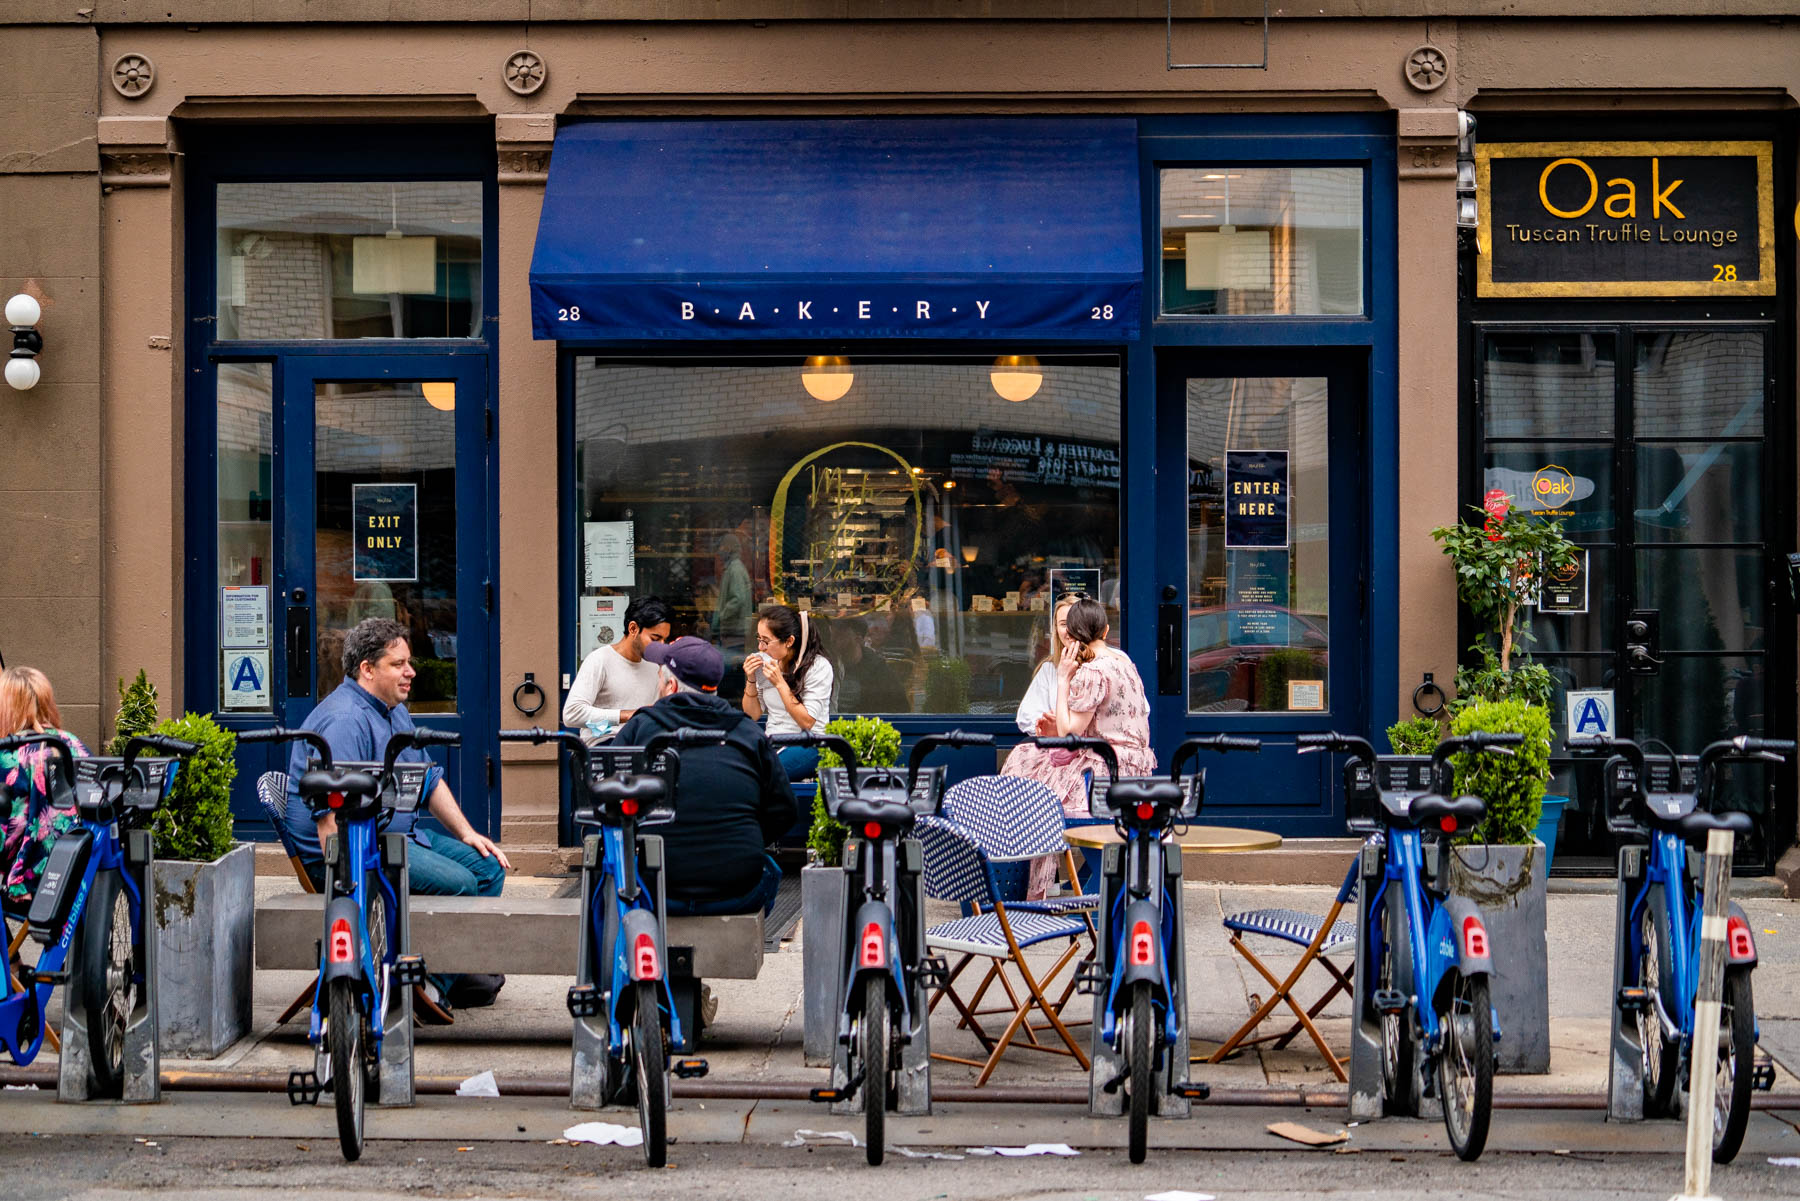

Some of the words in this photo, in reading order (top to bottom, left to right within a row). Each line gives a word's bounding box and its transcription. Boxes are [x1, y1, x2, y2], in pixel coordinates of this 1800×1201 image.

[1538, 157, 1686, 219] Oak
[1506, 224, 1580, 243] Tuscan
[1585, 223, 1651, 243] Truffle
[1659, 224, 1738, 247] Lounge
[1712, 264, 1738, 282] 28
[558, 306, 581, 322] 28
[1091, 304, 1114, 320] 28
[1234, 481, 1280, 495] ENTER
[1536, 477, 1570, 495] Oak
[1239, 503, 1275, 516] HERE
[368, 515, 401, 529] EXIT
[367, 536, 402, 549] ONLY
[232, 657, 262, 691] A
[1576, 698, 1607, 733] A
[68, 892, 85, 925] bike
